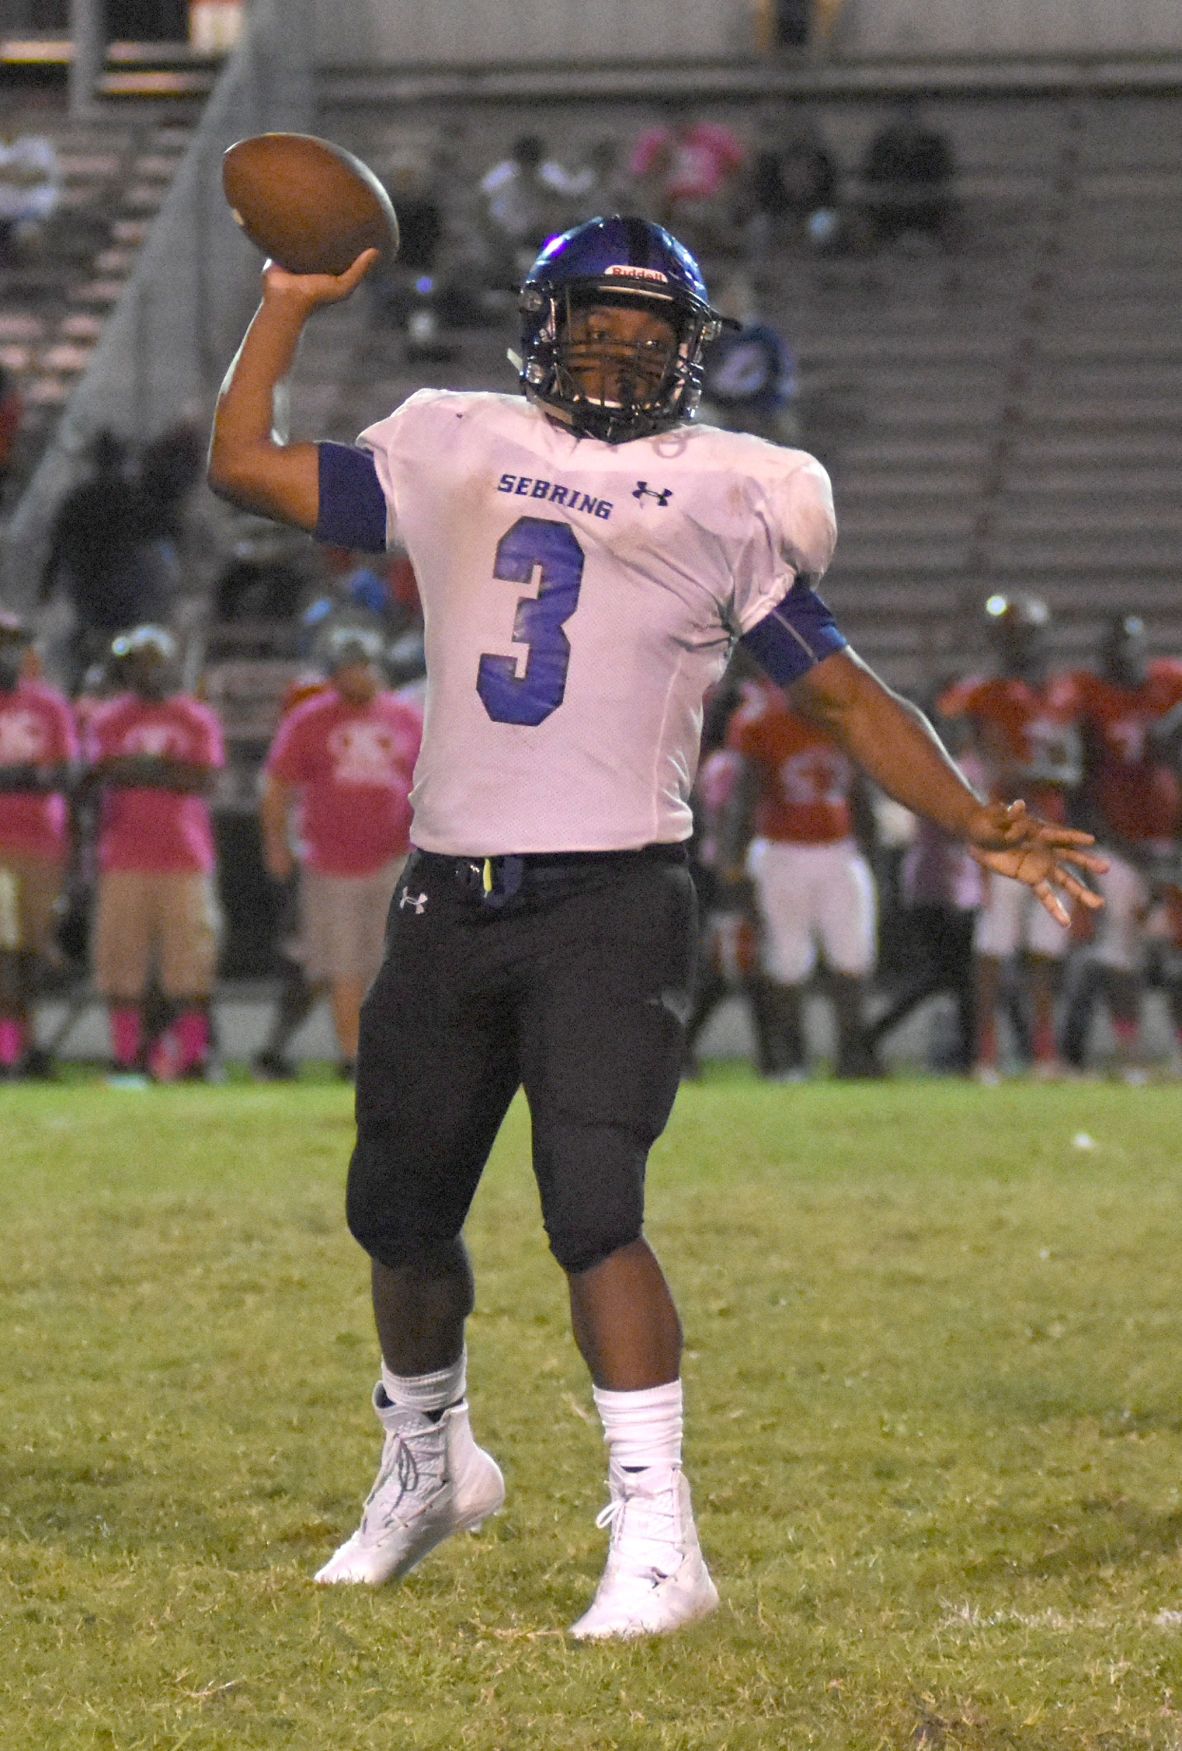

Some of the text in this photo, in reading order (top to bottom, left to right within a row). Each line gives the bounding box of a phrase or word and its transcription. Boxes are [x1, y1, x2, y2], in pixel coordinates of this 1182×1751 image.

[611, 266, 663, 281] Riddell
[497, 474, 613, 520] SEBRING
[476, 515, 585, 727] 3
